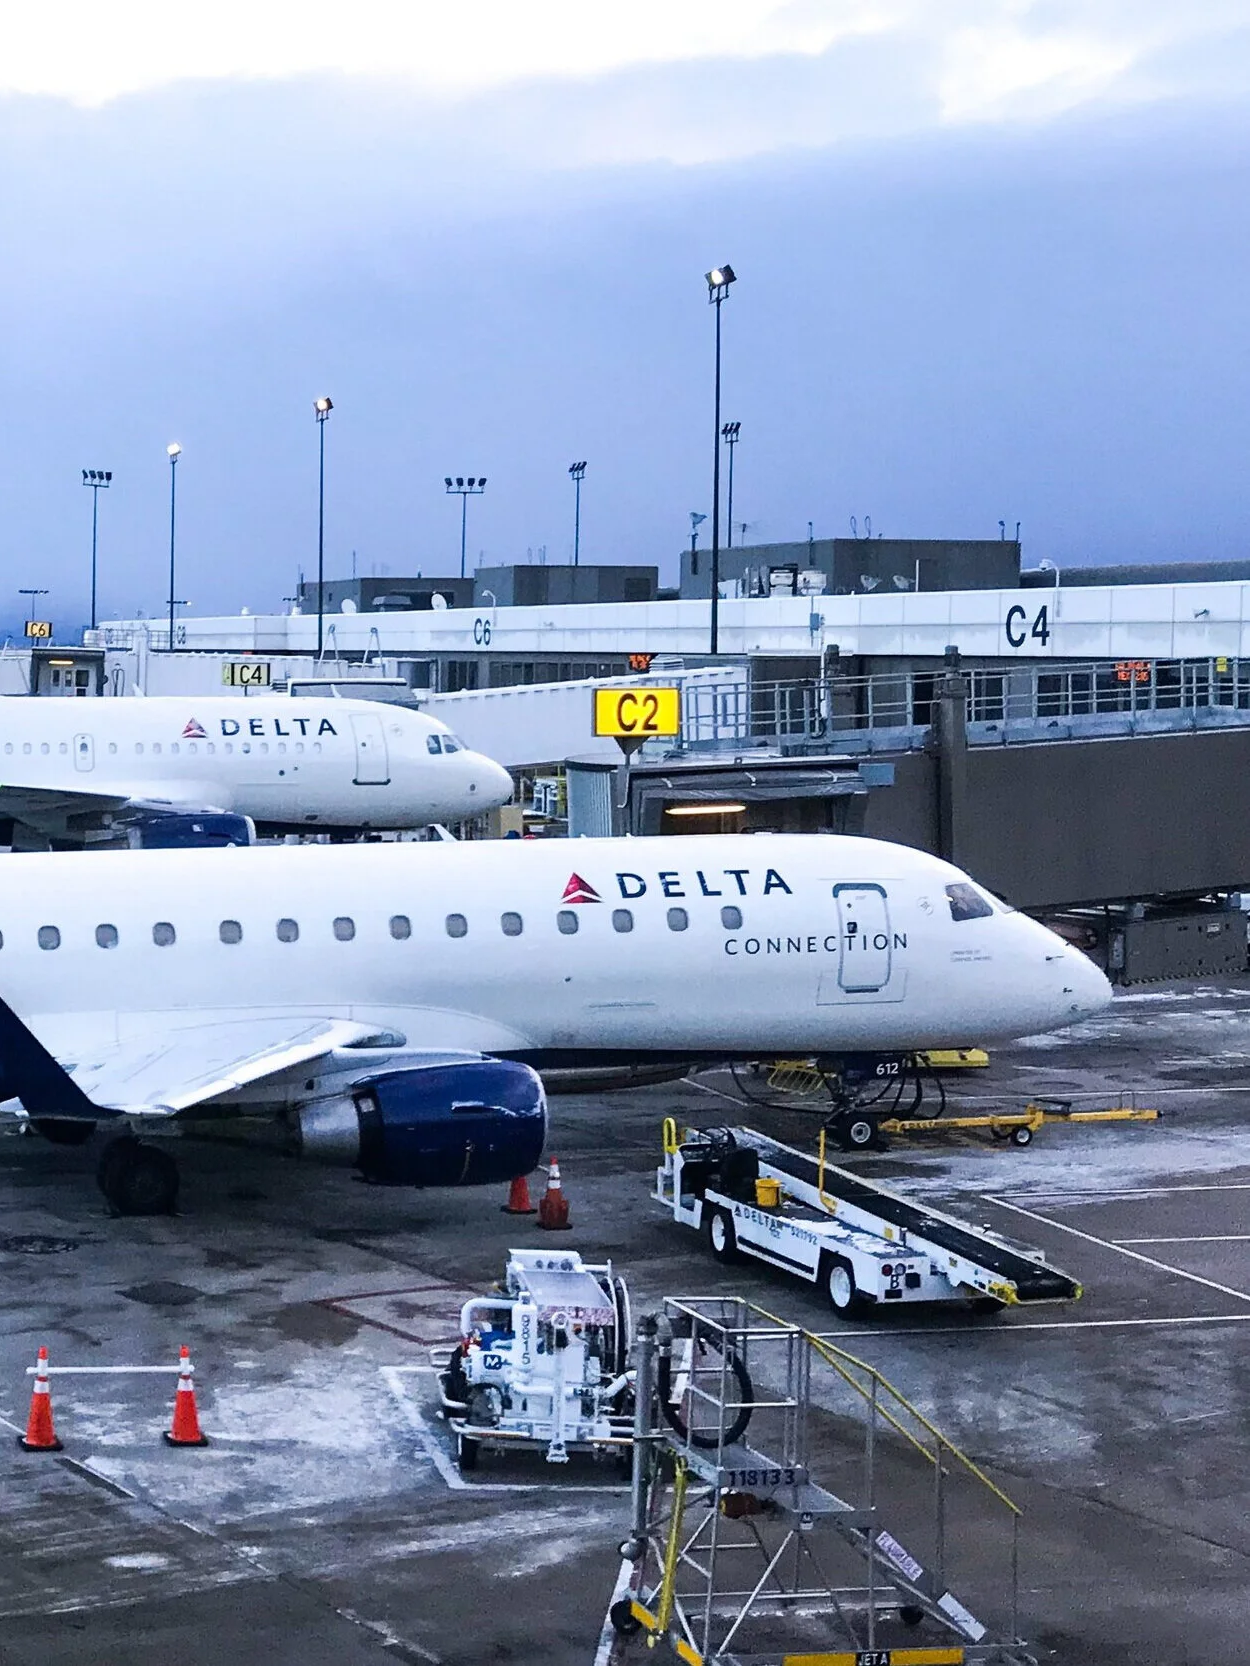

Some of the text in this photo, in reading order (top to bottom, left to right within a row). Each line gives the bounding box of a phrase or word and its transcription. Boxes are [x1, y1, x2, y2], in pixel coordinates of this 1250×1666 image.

[30, 623, 46, 637] C6
[474, 617, 491, 646] C6
[1005, 604, 1050, 648] C4
[239, 665, 262, 684] C4
[617, 693, 659, 732] C2
[221, 718, 338, 736] DELTA
[616, 868, 793, 899] DELTA
[724, 933, 908, 956] CONNECTION
[876, 1062, 899, 1076] 612
[743, 1207, 778, 1230] DELTA
[729, 1468, 795, 1486] 118133
[858, 1652, 888, 1666] JET A
